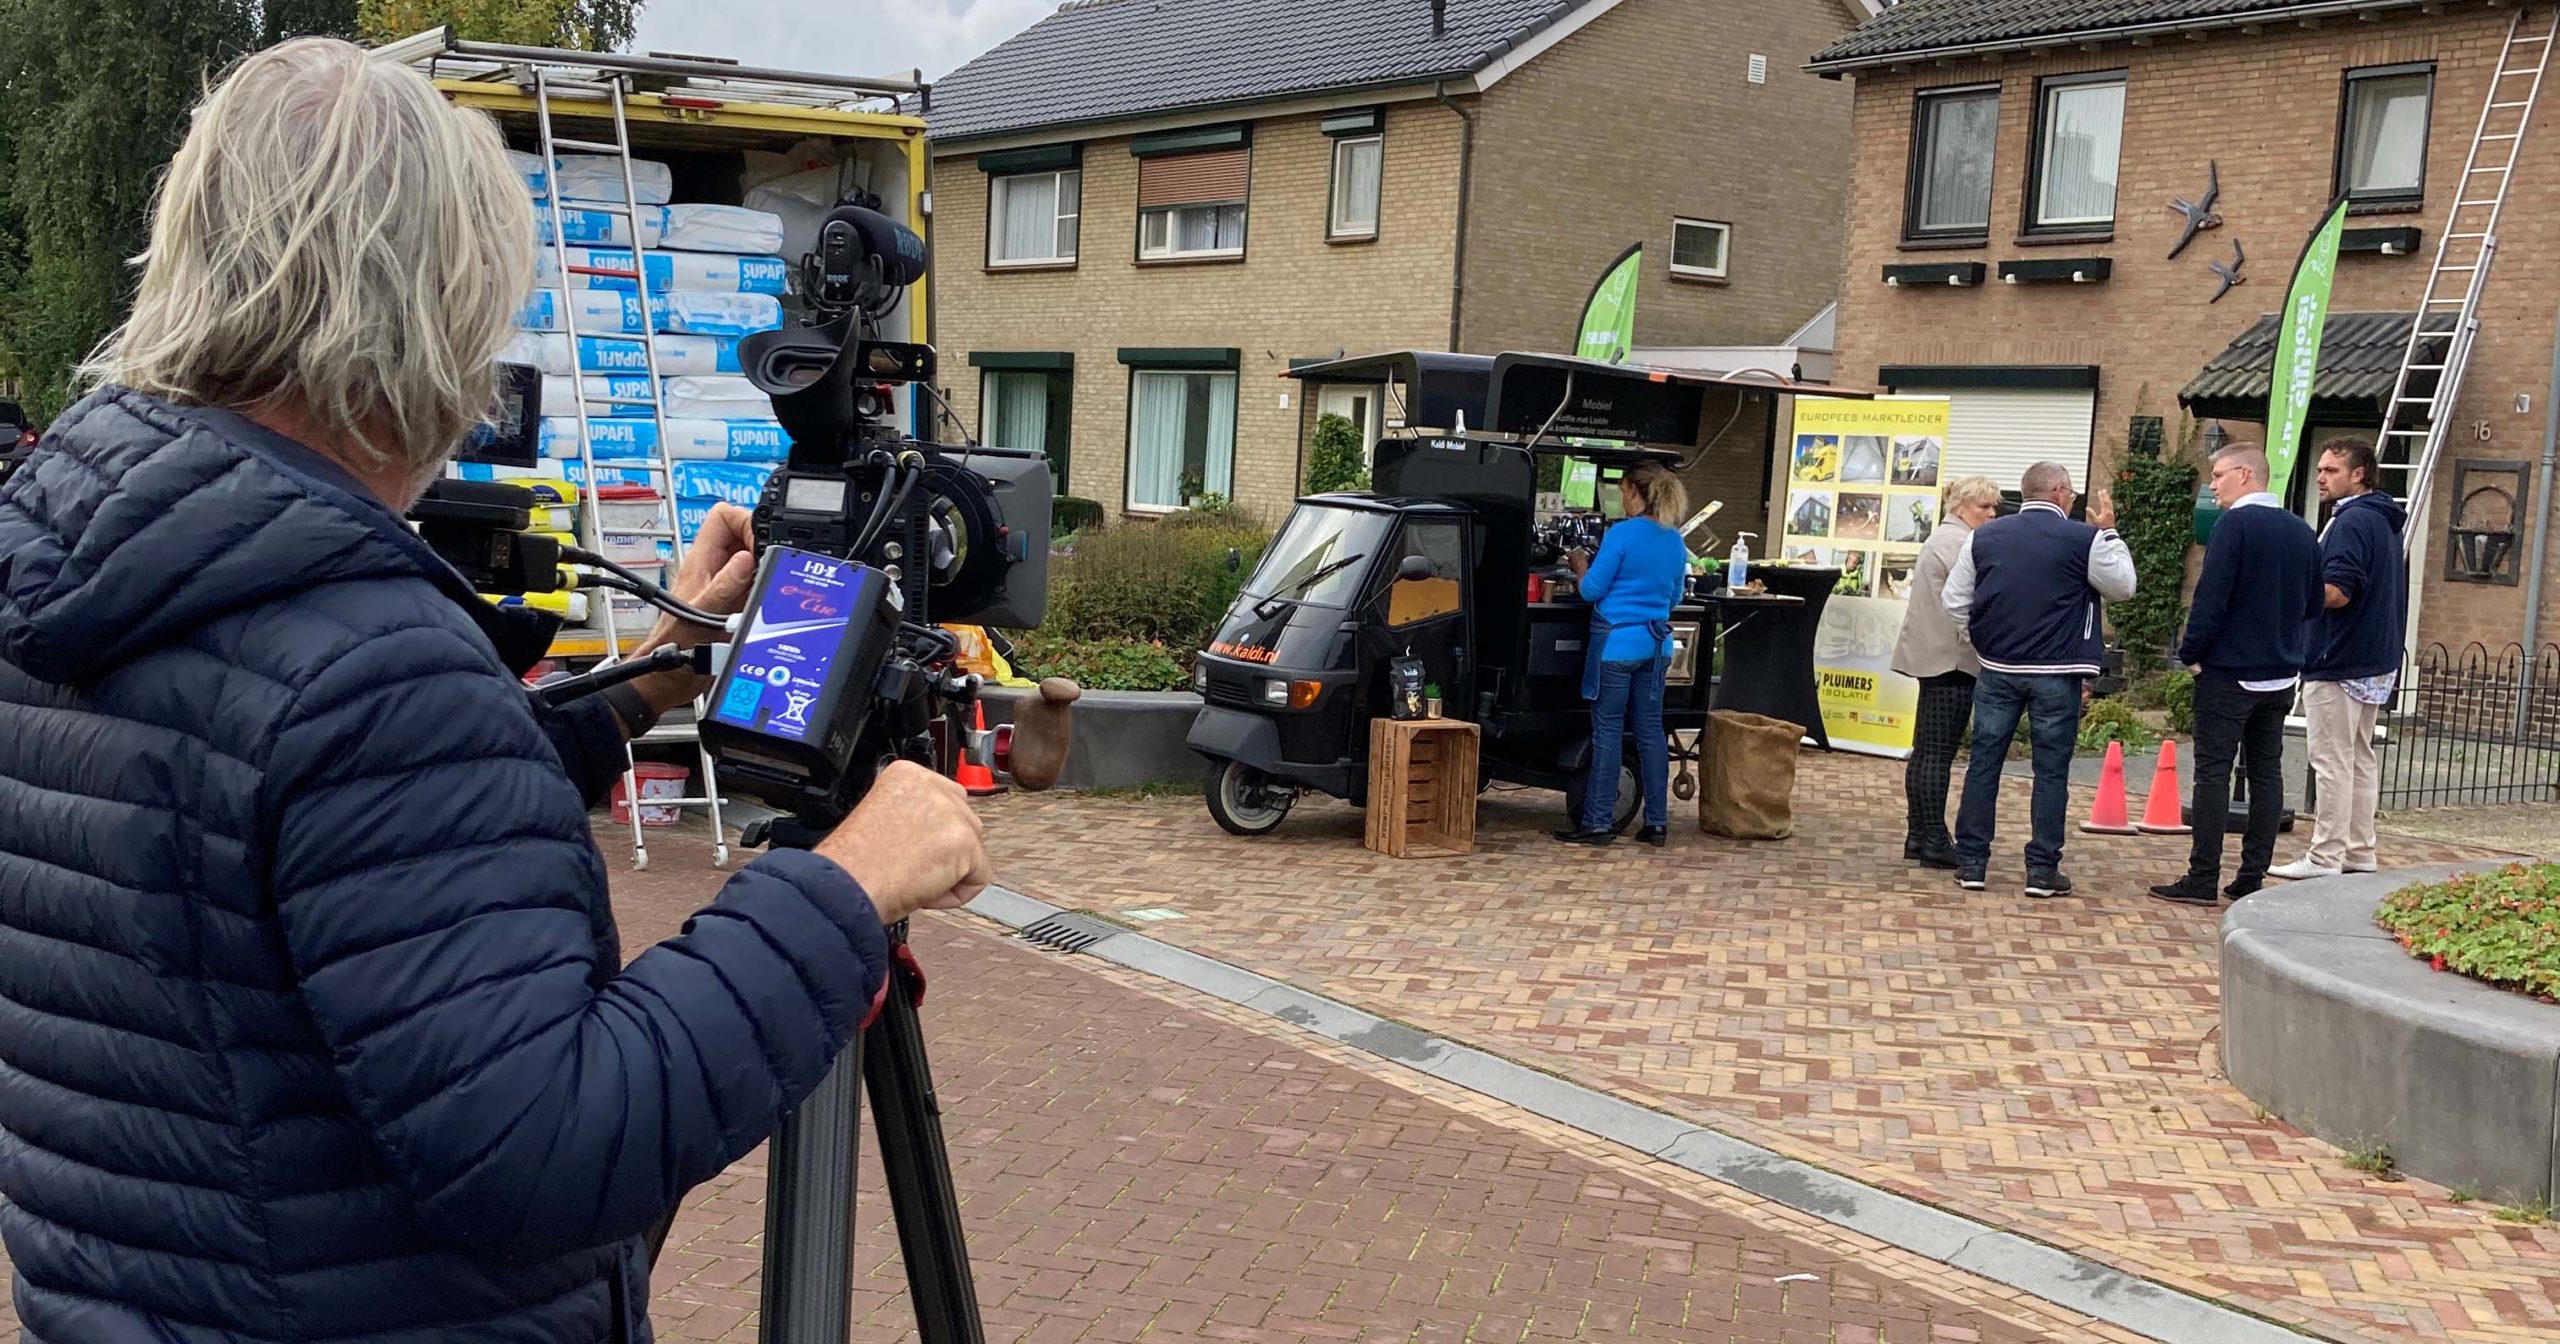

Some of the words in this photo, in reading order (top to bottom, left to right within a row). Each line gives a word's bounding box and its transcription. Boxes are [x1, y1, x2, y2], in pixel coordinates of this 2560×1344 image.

[1582, 399, 1613, 411] Mobiel
[1800, 412, 1858, 422] EUROPEES
[1862, 413, 1942, 424] MARKTLEIDER
[588, 424, 636, 442] UPAFIL
[731, 430, 781, 446] SUPAFIL
[2471, 420, 2491, 440] 16
[1430, 439, 1446, 449] Kaldi
[567, 466, 624, 482] SUAFIL
[1210, 641, 1281, 664] www.kaldi.nl
[1823, 673, 1873, 692] PLUIMERS
[1822, 688, 1872, 701] ISOLATIE
